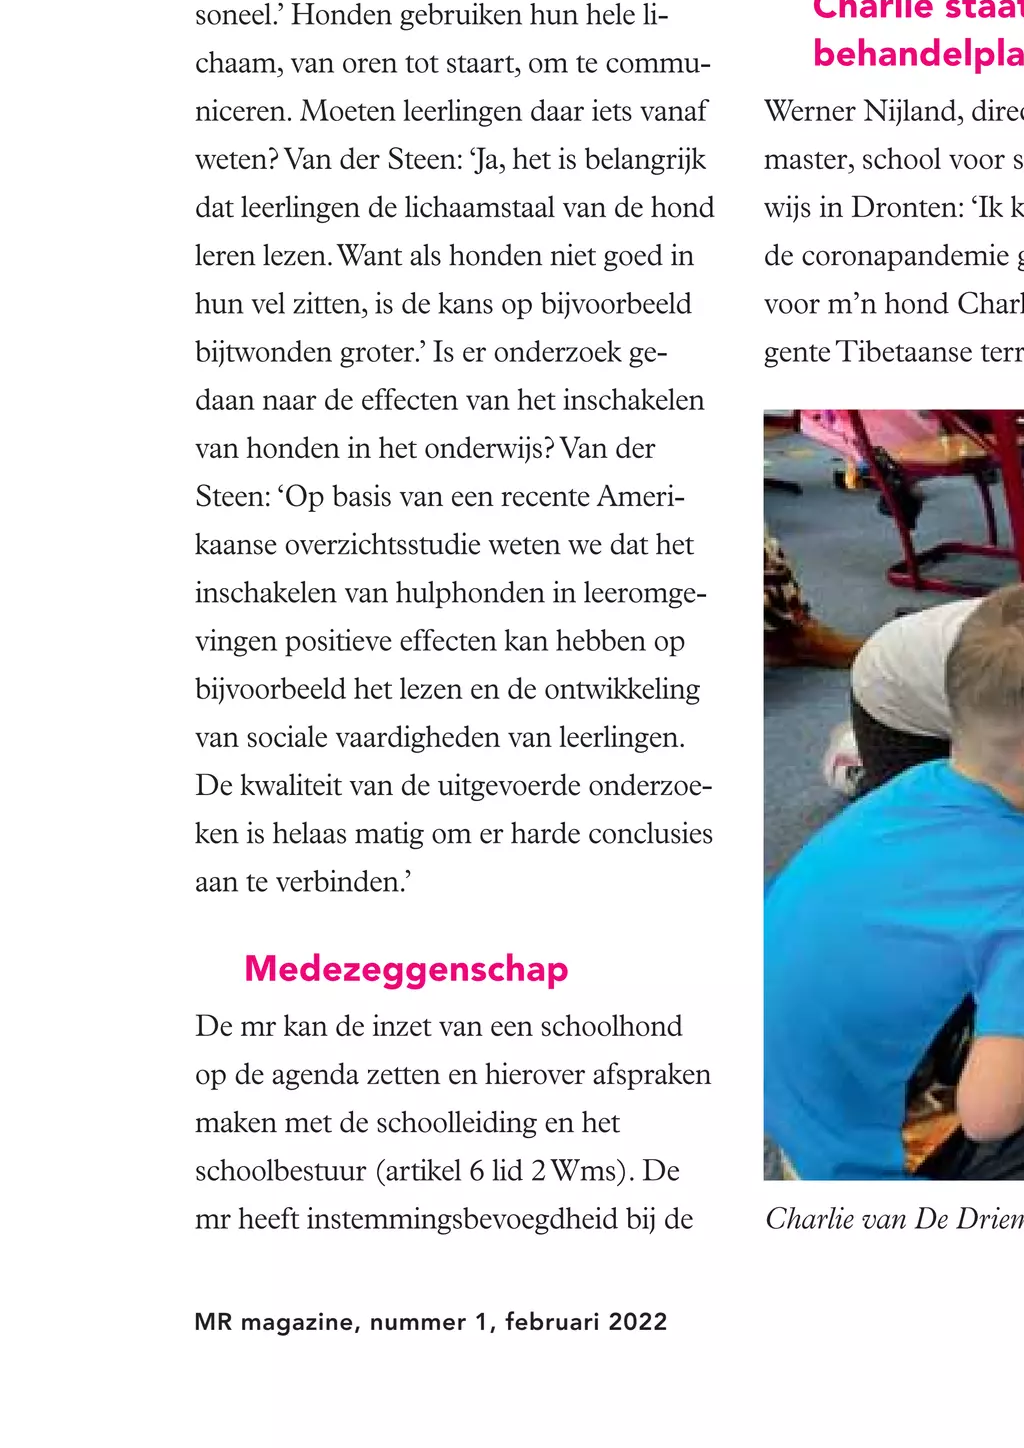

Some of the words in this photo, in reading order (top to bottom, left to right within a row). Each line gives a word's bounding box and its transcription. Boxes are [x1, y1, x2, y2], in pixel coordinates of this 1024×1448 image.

[195, 98, 292, 122] niceren.
[299, 98, 396, 122] Moeten
[403, 98, 523, 128] leerlingen
[530, 98, 585, 122] daar
[591, 98, 632, 122] iets
[640, 98, 710, 122] vanaf
[194, 339, 333, 368] bijtwonden
[433, 339, 454, 363] Is
[462, 346, 487, 363] er
[494, 339, 623, 363] onderzoek
[628, 346, 668, 369] ge-
[764, 344, 831, 369] gente
[835, 339, 973, 363] Tibetaanse
[195, 580, 337, 604] inschakelen
[344, 587, 389, 604] van
[395, 580, 546, 609] hulphonden
[552, 580, 577, 604] in
[583, 580, 707, 609] leeromge-
[195, 773, 233, 796] De
[240, 772, 343, 797] kwaliteit
[349, 780, 394, 796] van
[401, 773, 431, 796] de
[437, 772, 581, 802] uitgevoerde
[588, 773, 713, 797] onderzoe-
[245, 952, 569, 991] Medezeggenschap
[195, 1213, 232, 1230] mr
[238, 1206, 300, 1230] heeft
[306, 1206, 619, 1236] instemmingsbevoegdheid
[625, 1206, 656, 1235] bij
[664, 1206, 694, 1230] de
[766, 1206, 855, 1230] Charlie
[861, 1213, 907, 1230] van
[914, 1206, 949, 1230] De
[195, 1312, 233, 1331] MR
[241, 1312, 361, 1337] magazine,
[370, 1317, 467, 1331] nummer
[475, 1312, 496, 1334] 1,
[504, 1310, 599, 1331] februari
[609, 1311, 667, 1331] 2022
